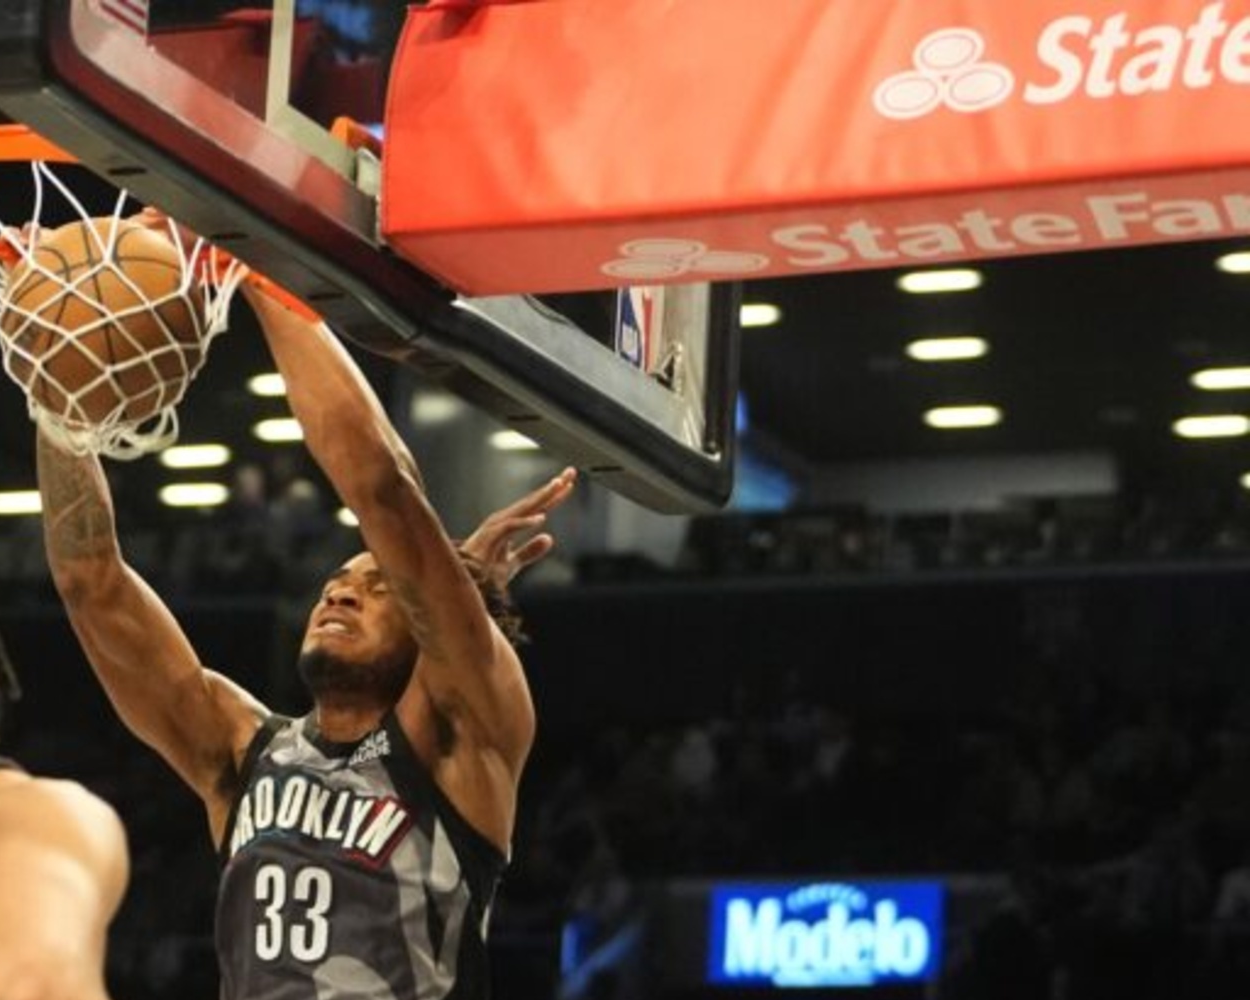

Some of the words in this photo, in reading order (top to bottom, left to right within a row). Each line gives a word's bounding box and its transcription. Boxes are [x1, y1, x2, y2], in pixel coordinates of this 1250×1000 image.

[1023, 0, 1250, 105] State
[772, 211, 1082, 267] State
[230, 775, 407, 858] ROOKLYN
[254, 863, 332, 963] 33
[724, 897, 930, 977] Modelo
